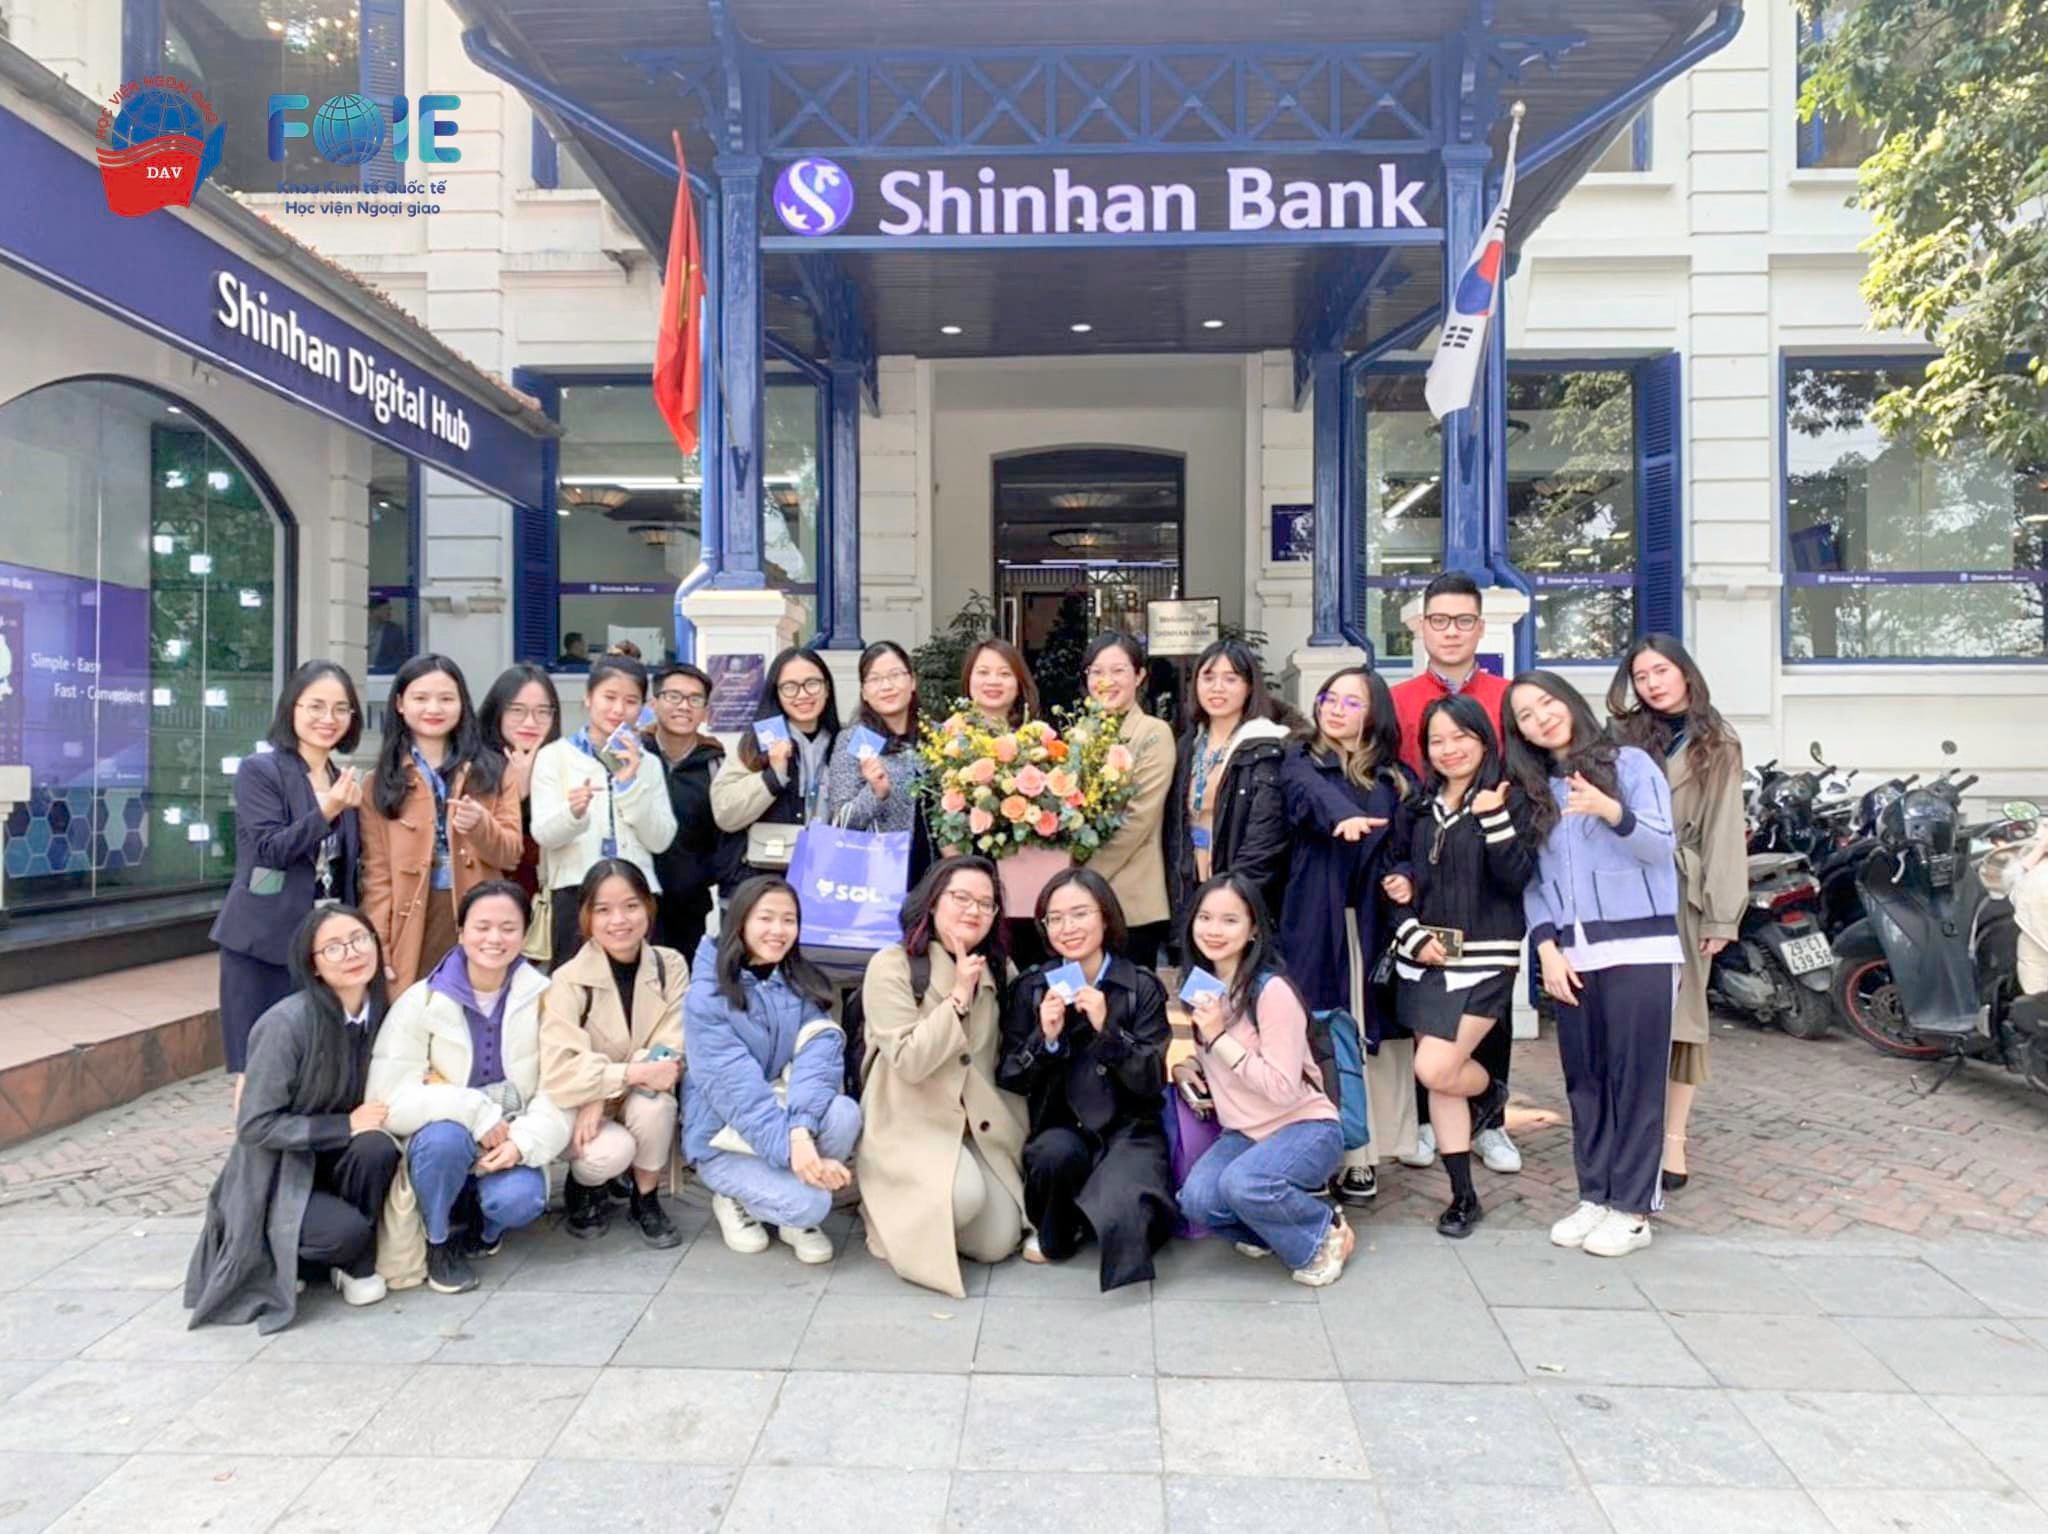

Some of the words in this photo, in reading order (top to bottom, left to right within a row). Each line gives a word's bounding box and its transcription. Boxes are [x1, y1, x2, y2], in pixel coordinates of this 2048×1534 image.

[878, 166, 1196, 236] Shinhan
[1227, 163, 1428, 232] Bank
[217, 271, 342, 383] Shinhan
[348, 346, 427, 430] Digital
[431, 395, 471, 451] Hub
[31, 652, 70, 673] Simple
[54, 682, 77, 698] Fast
[834, 884, 881, 903] SOL
